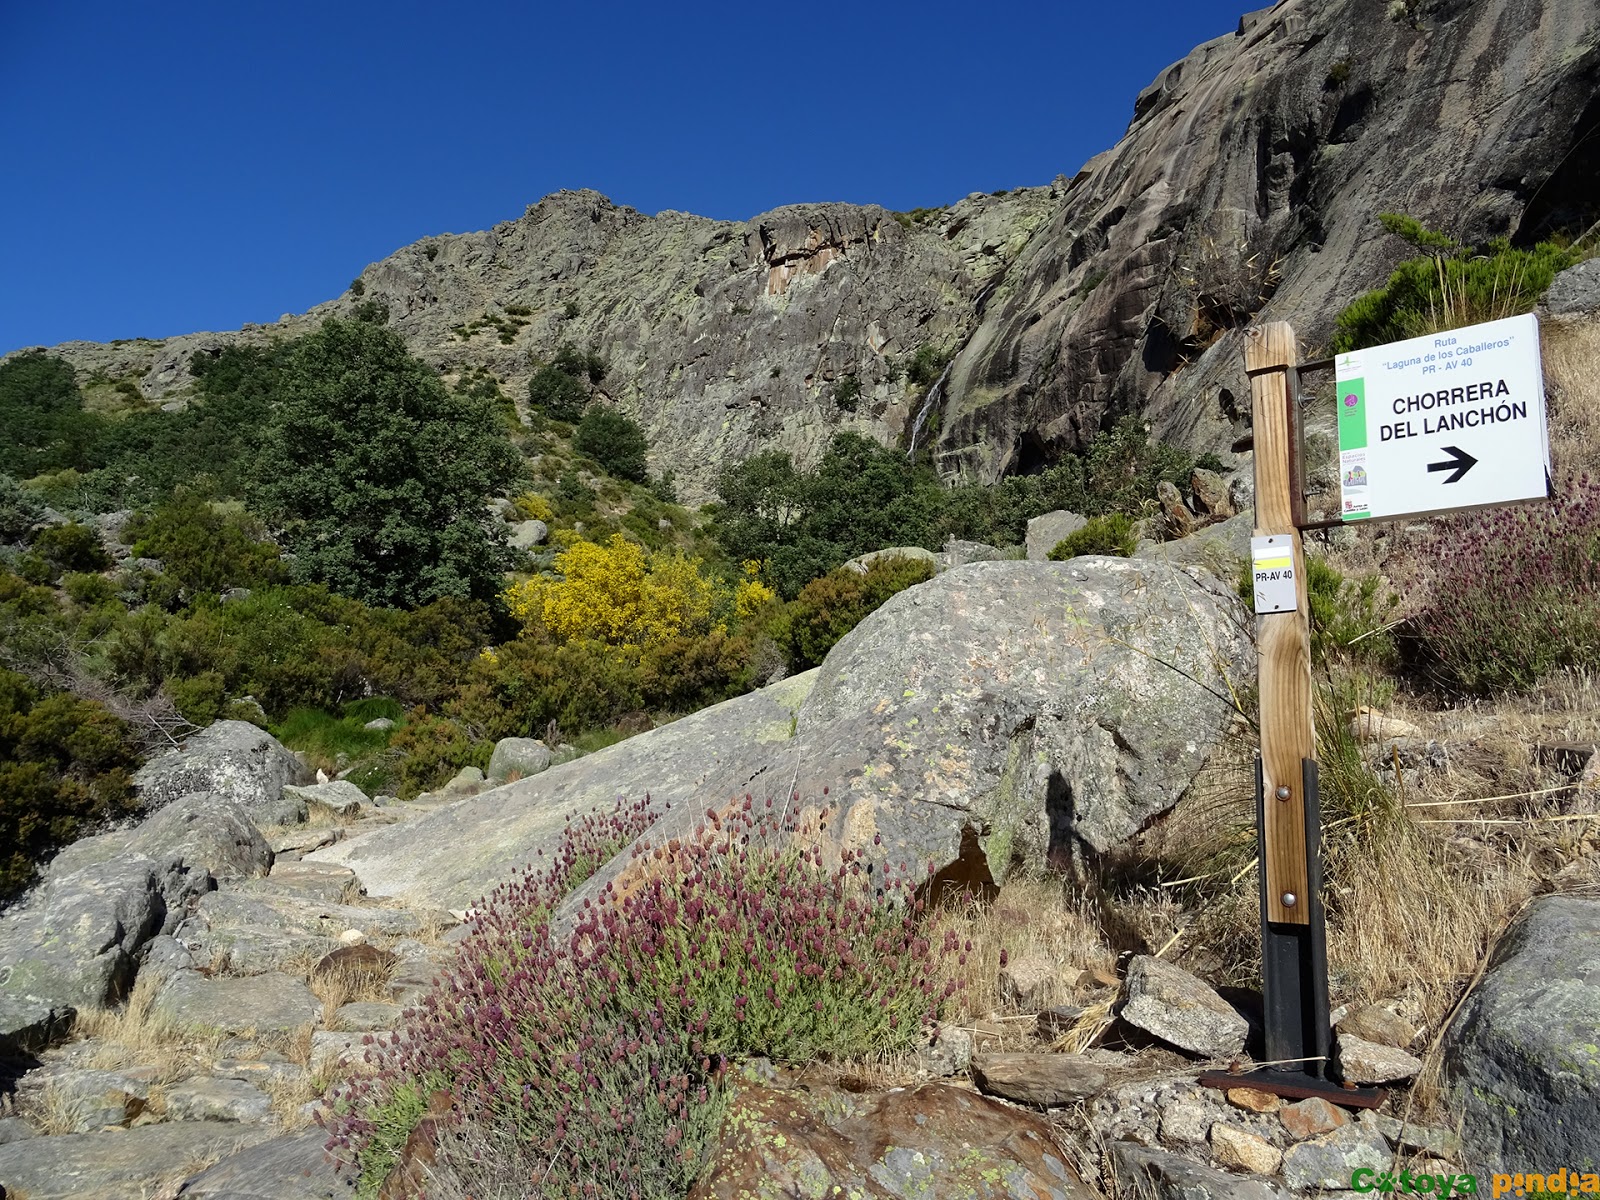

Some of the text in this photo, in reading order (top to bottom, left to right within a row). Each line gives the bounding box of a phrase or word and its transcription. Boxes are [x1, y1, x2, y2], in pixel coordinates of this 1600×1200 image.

[1434, 337, 1457, 348] Ruta
[1424, 354, 1436, 363] de
[1438, 351, 1453, 360] los
[1422, 365, 1436, 375] PR
[1445, 360, 1458, 371] AV
[1461, 357, 1473, 367] 40
[1392, 379, 1510, 415] CHORRERA
[1380, 400, 1527, 442] DEL LANCHÓN
[1255, 569, 1293, 582] PR-AV 40
